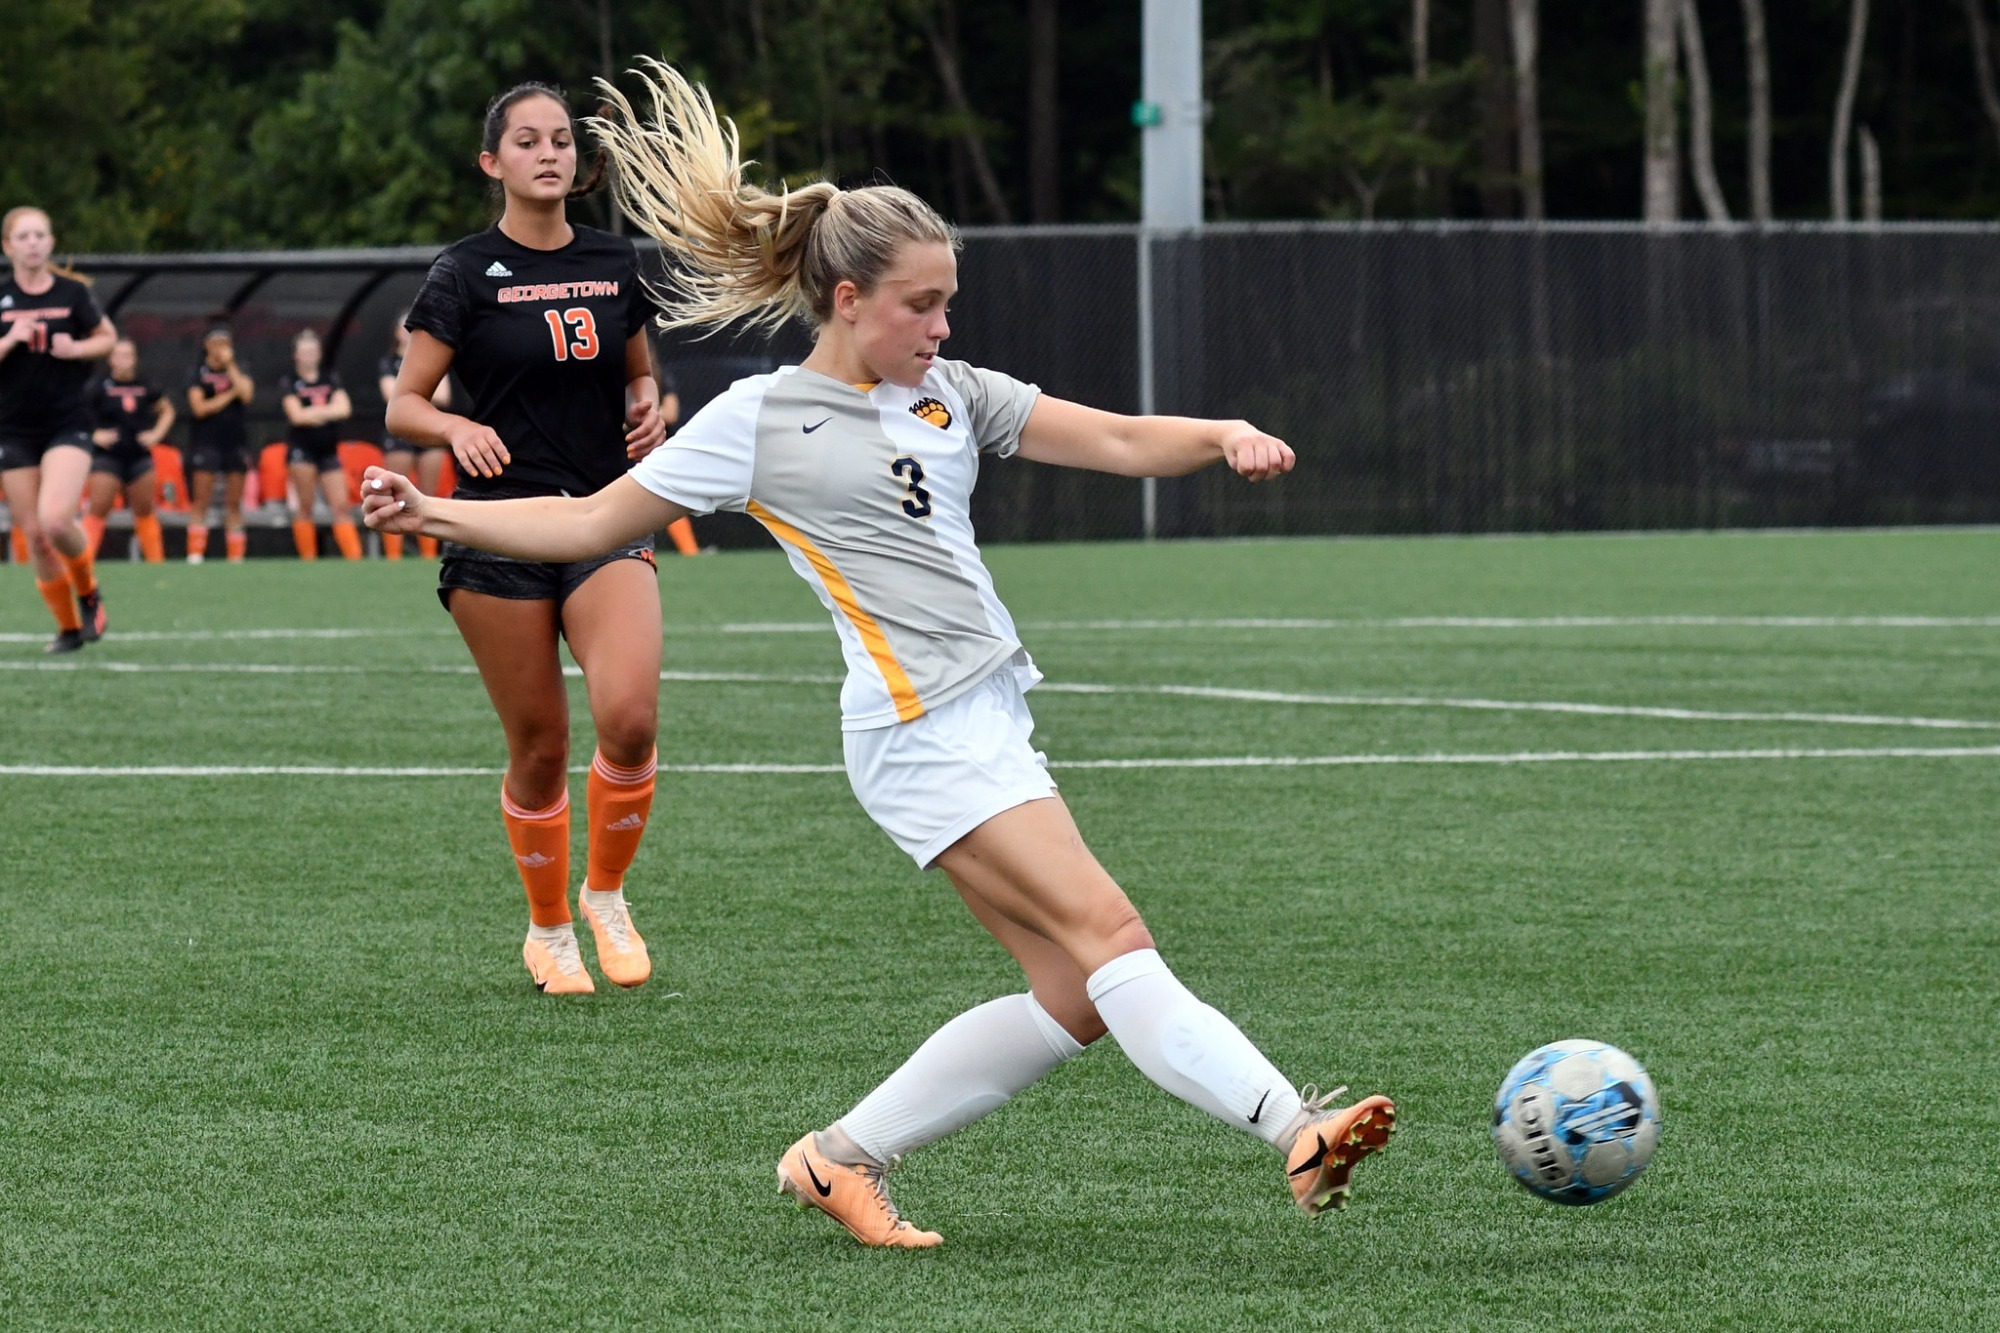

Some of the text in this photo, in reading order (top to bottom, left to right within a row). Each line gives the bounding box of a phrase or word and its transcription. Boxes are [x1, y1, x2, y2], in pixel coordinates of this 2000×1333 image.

[498, 281, 618, 303] GEORGETOWN
[544, 307, 599, 362] 13
[889, 454, 935, 521] 3
